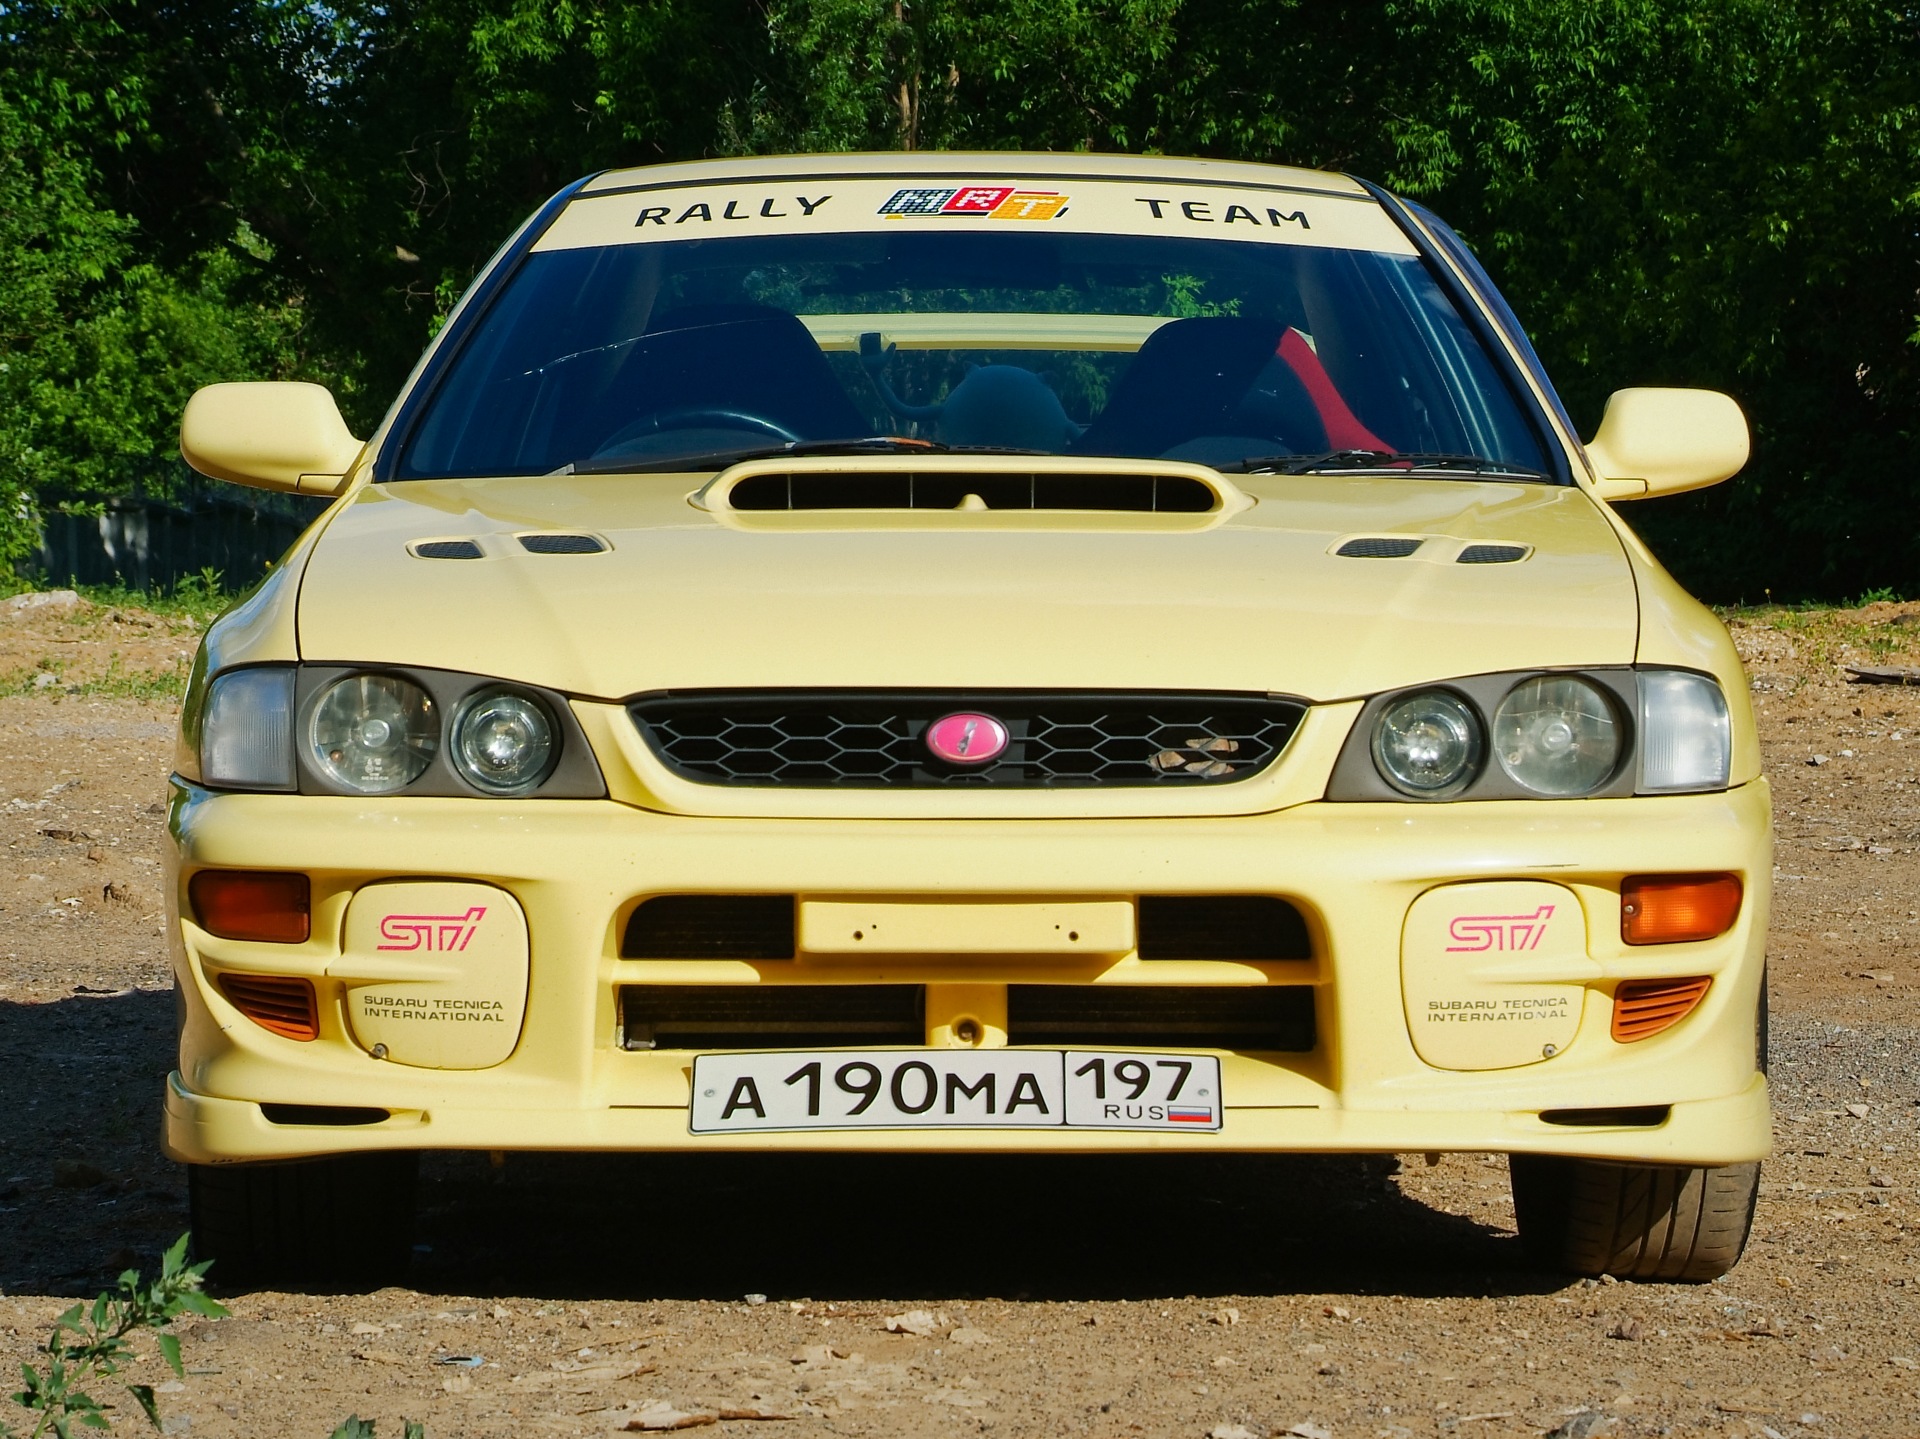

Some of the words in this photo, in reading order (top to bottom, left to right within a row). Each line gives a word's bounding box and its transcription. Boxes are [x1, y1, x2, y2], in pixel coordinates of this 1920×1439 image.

[635, 195, 833, 227] RALLY
[1136, 198, 1311, 229] TEAM
[364, 995, 427, 1008] SUBARU
[433, 999, 503, 1010] TECNICA
[1428, 1001, 1497, 1010] SUBARU
[1503, 997, 1568, 1009] TECNICA
[364, 1007, 504, 1022] INTERNATIONAL
[1428, 1010, 1567, 1022] INTERNATIONAL
[1075, 1058, 1193, 1101] 197
[1104, 1104, 1164, 1121] RUS
